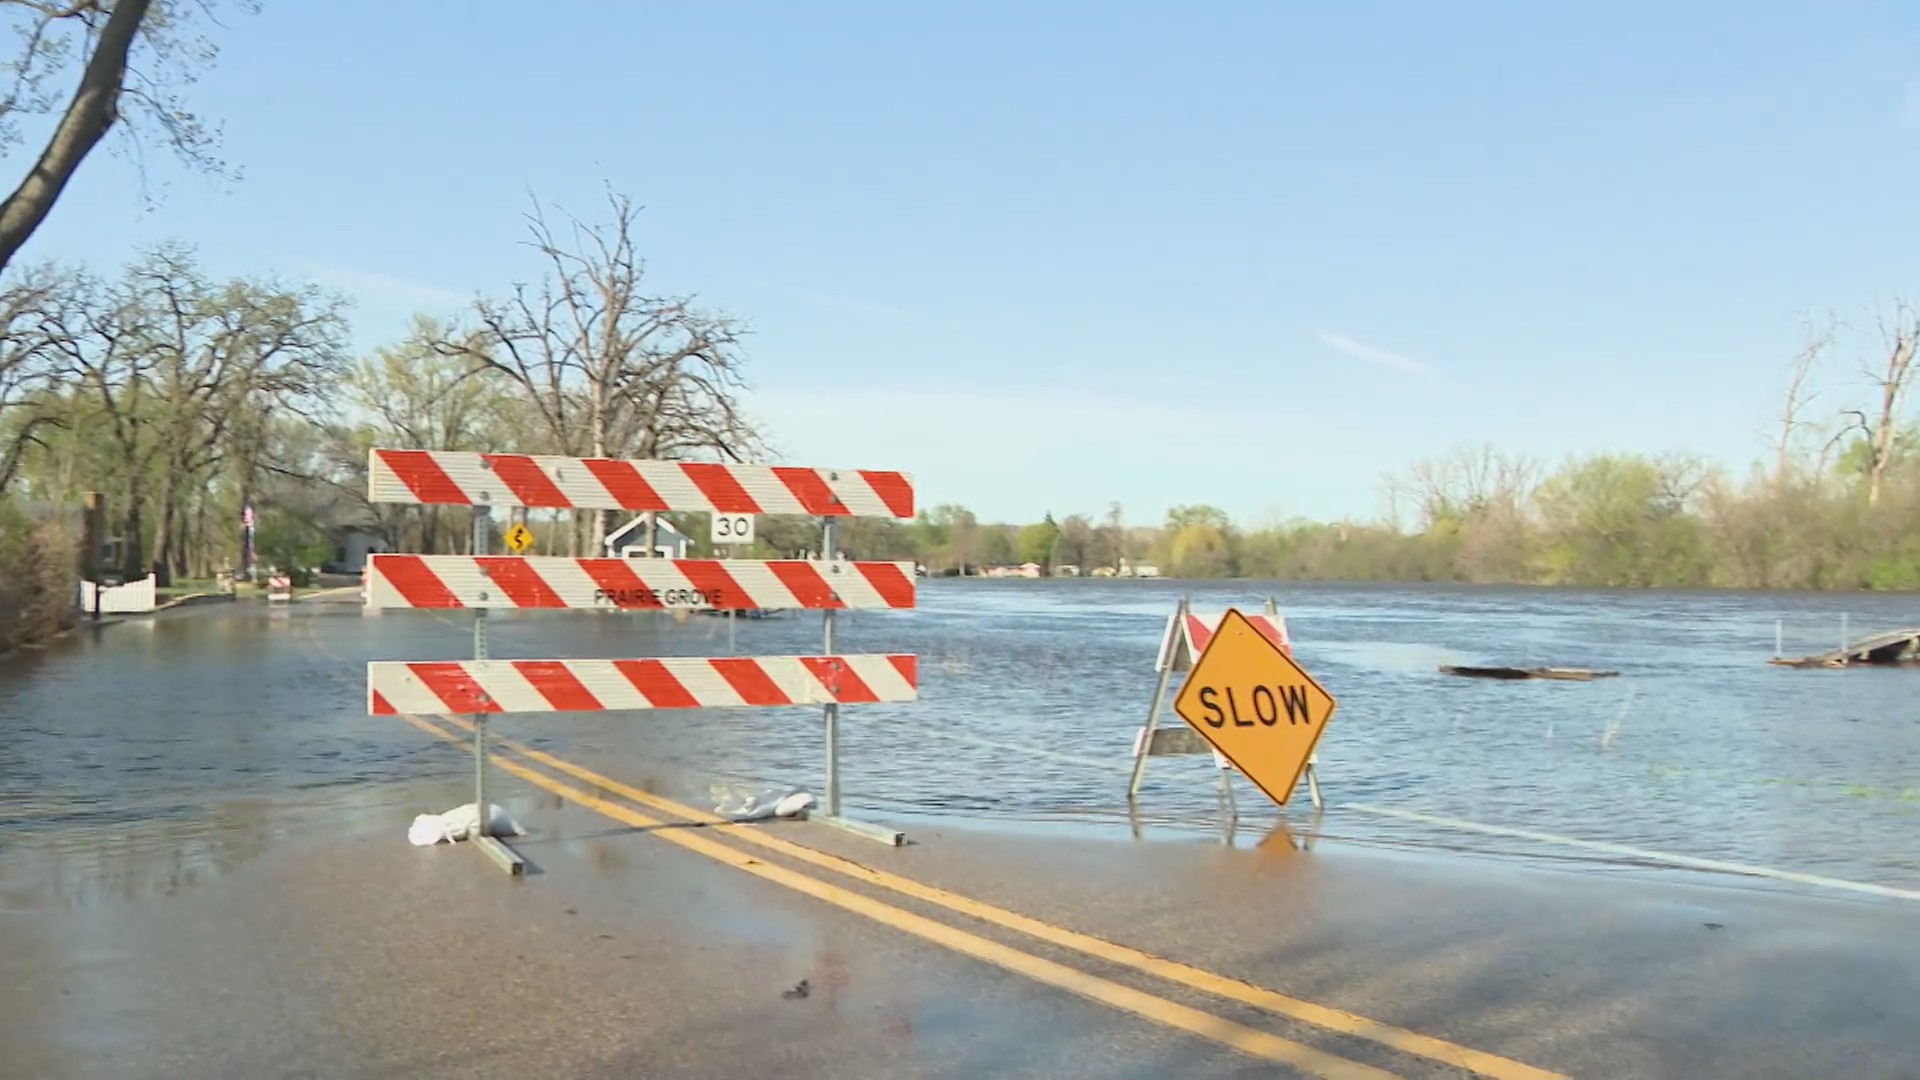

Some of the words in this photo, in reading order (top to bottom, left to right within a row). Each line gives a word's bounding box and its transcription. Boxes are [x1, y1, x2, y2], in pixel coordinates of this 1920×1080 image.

[717, 517, 749, 536] 30
[664, 588, 722, 605] GROVE
[1199, 684, 1311, 728] SLOW
